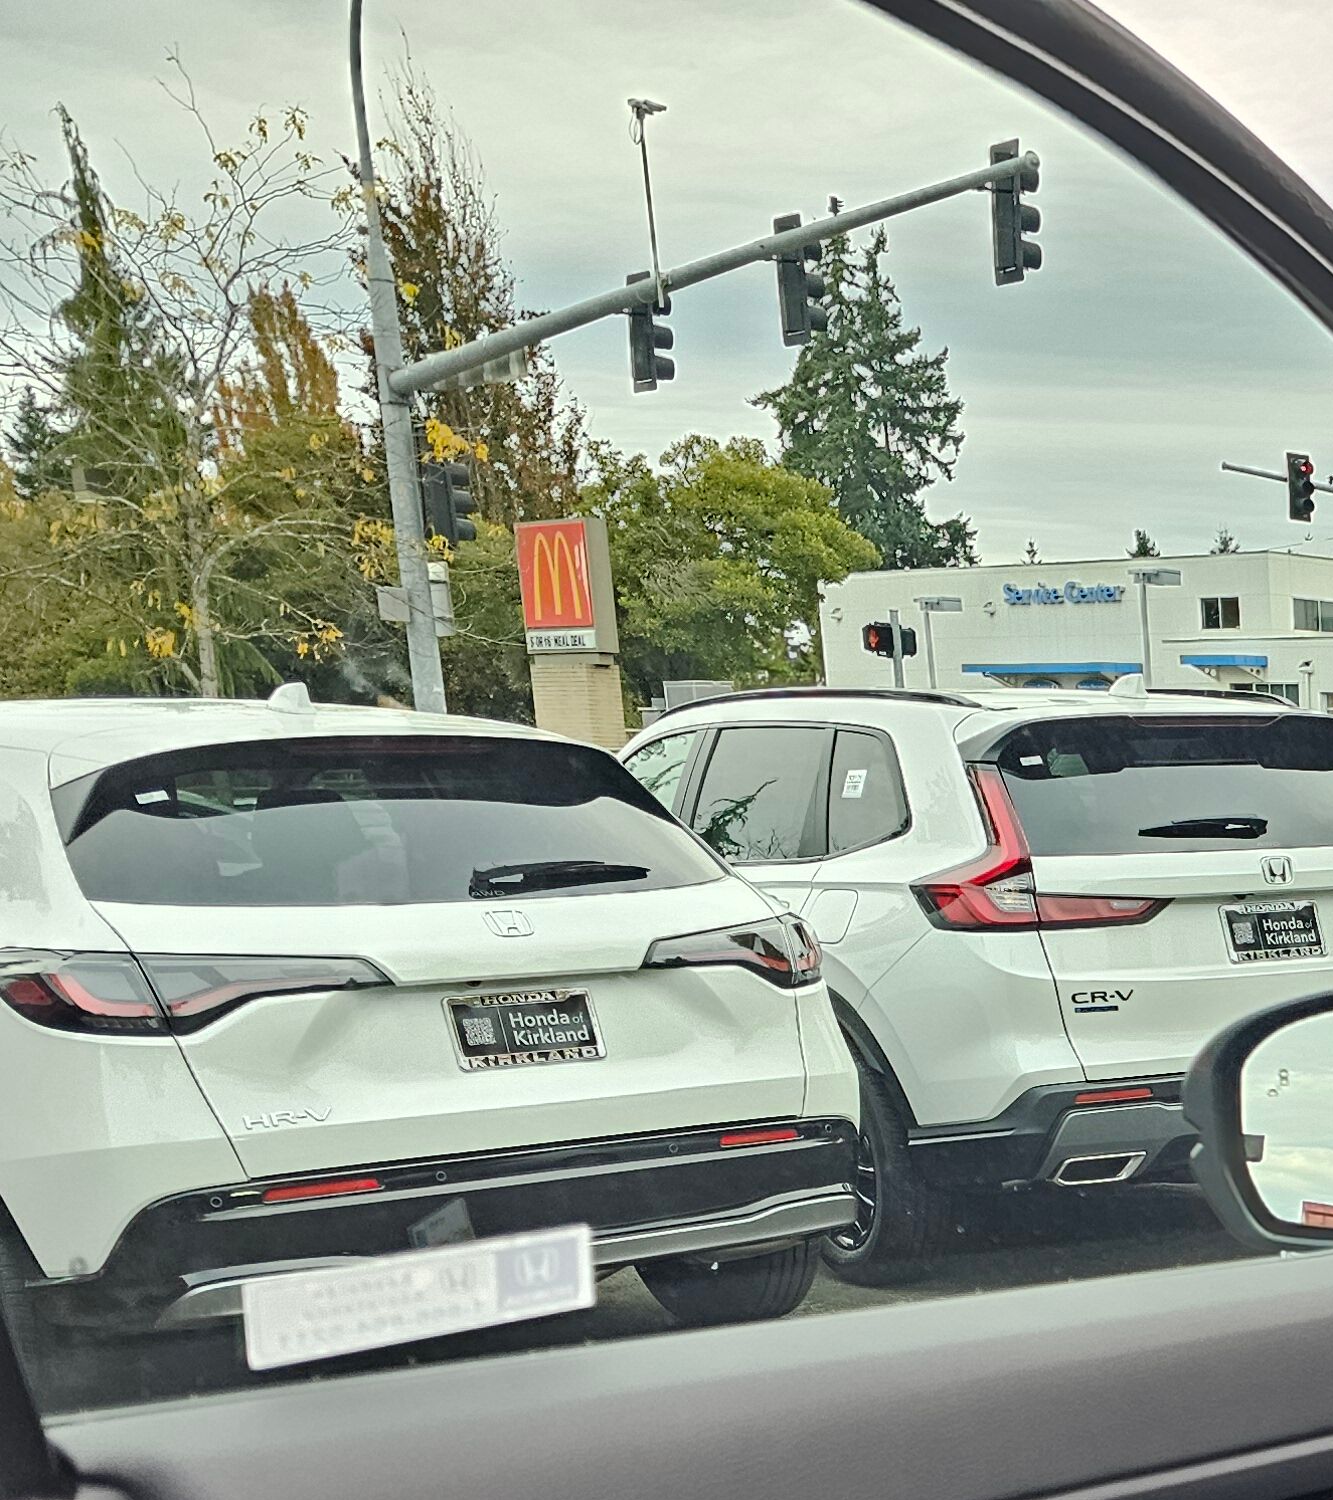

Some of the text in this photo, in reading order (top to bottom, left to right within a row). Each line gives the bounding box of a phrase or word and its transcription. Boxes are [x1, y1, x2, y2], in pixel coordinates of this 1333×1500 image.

[1003, 581, 1122, 606] Service Center
[470, 889, 506, 898] AWD
[1262, 917, 1313, 931] Honda of
[1265, 929, 1317, 945] Kirkland
[482, 991, 556, 1006] HONDA
[1071, 989, 1134, 1004] CR-V
[509, 1009, 584, 1028] Honda of
[513, 1025, 590, 1046] Kirkland
[470, 1046, 596, 1069] KIRKLAND
[243, 1106, 332, 1130] HR-V
